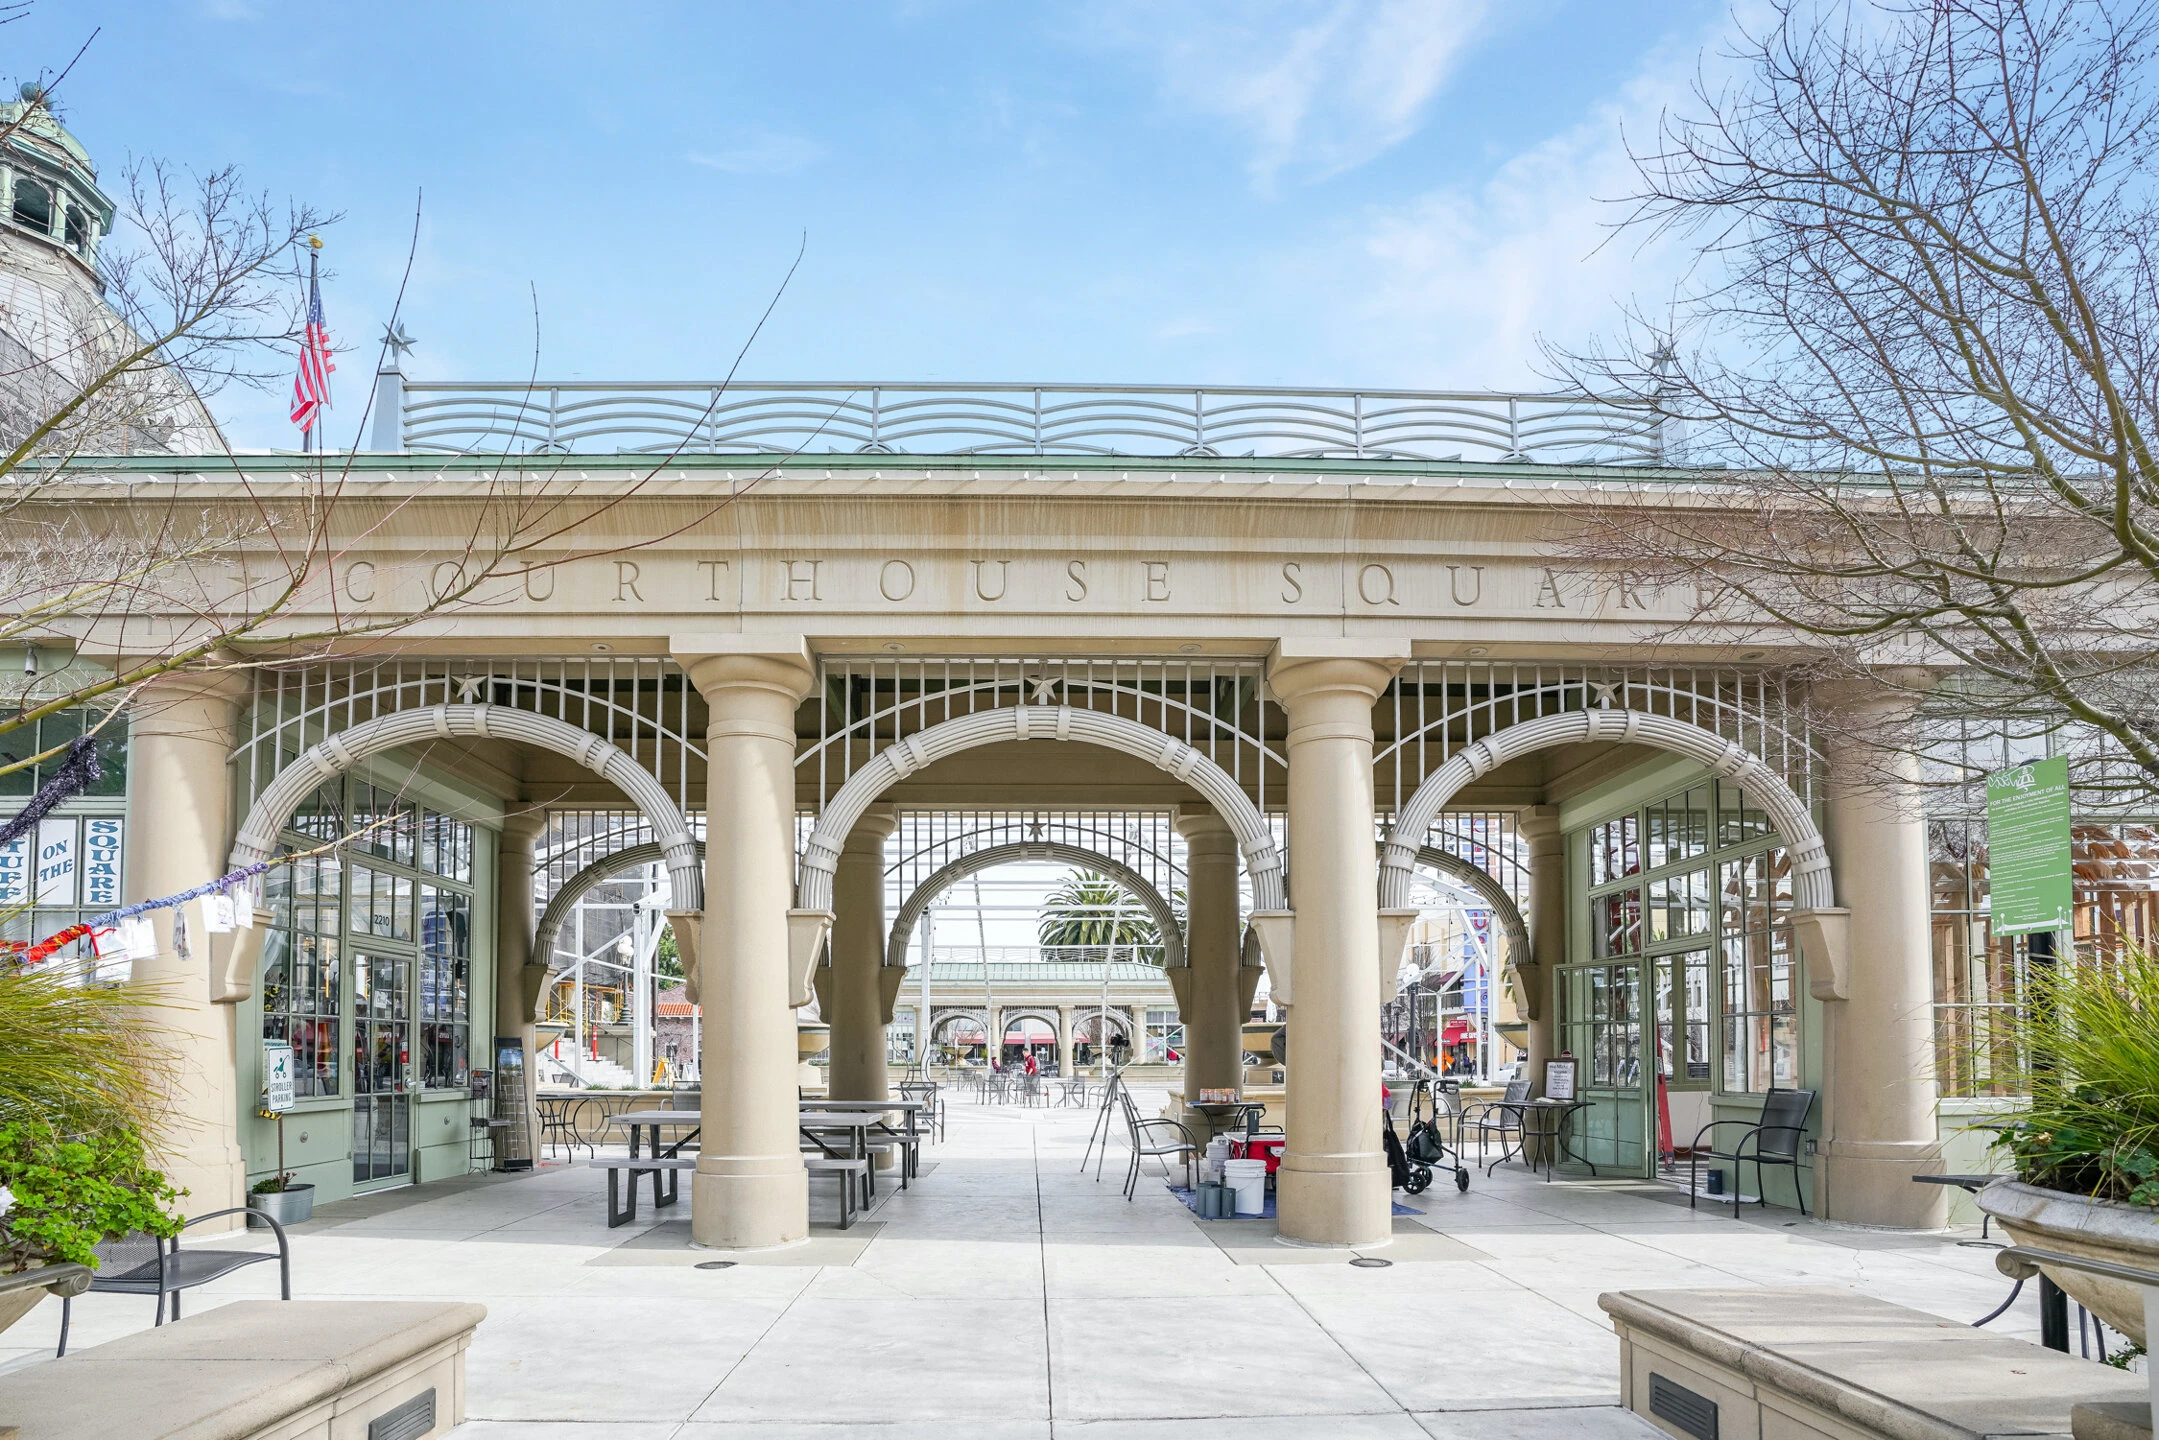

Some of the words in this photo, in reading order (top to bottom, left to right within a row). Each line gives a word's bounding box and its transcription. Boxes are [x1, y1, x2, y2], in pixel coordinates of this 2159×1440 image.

[345, 559, 1171, 603] COURTHOUSE
[2012, 789, 2045, 801] ENJOYMENT
[42, 839, 68, 860] ON
[0, 824, 26, 899] TUFF
[39, 858, 73, 882] THE
[88, 820, 119, 903] SQUARE
[374, 914, 389, 926] 2210
[271, 1081, 292, 1092] STROLLER
[272, 1092, 292, 1104] PARKING
